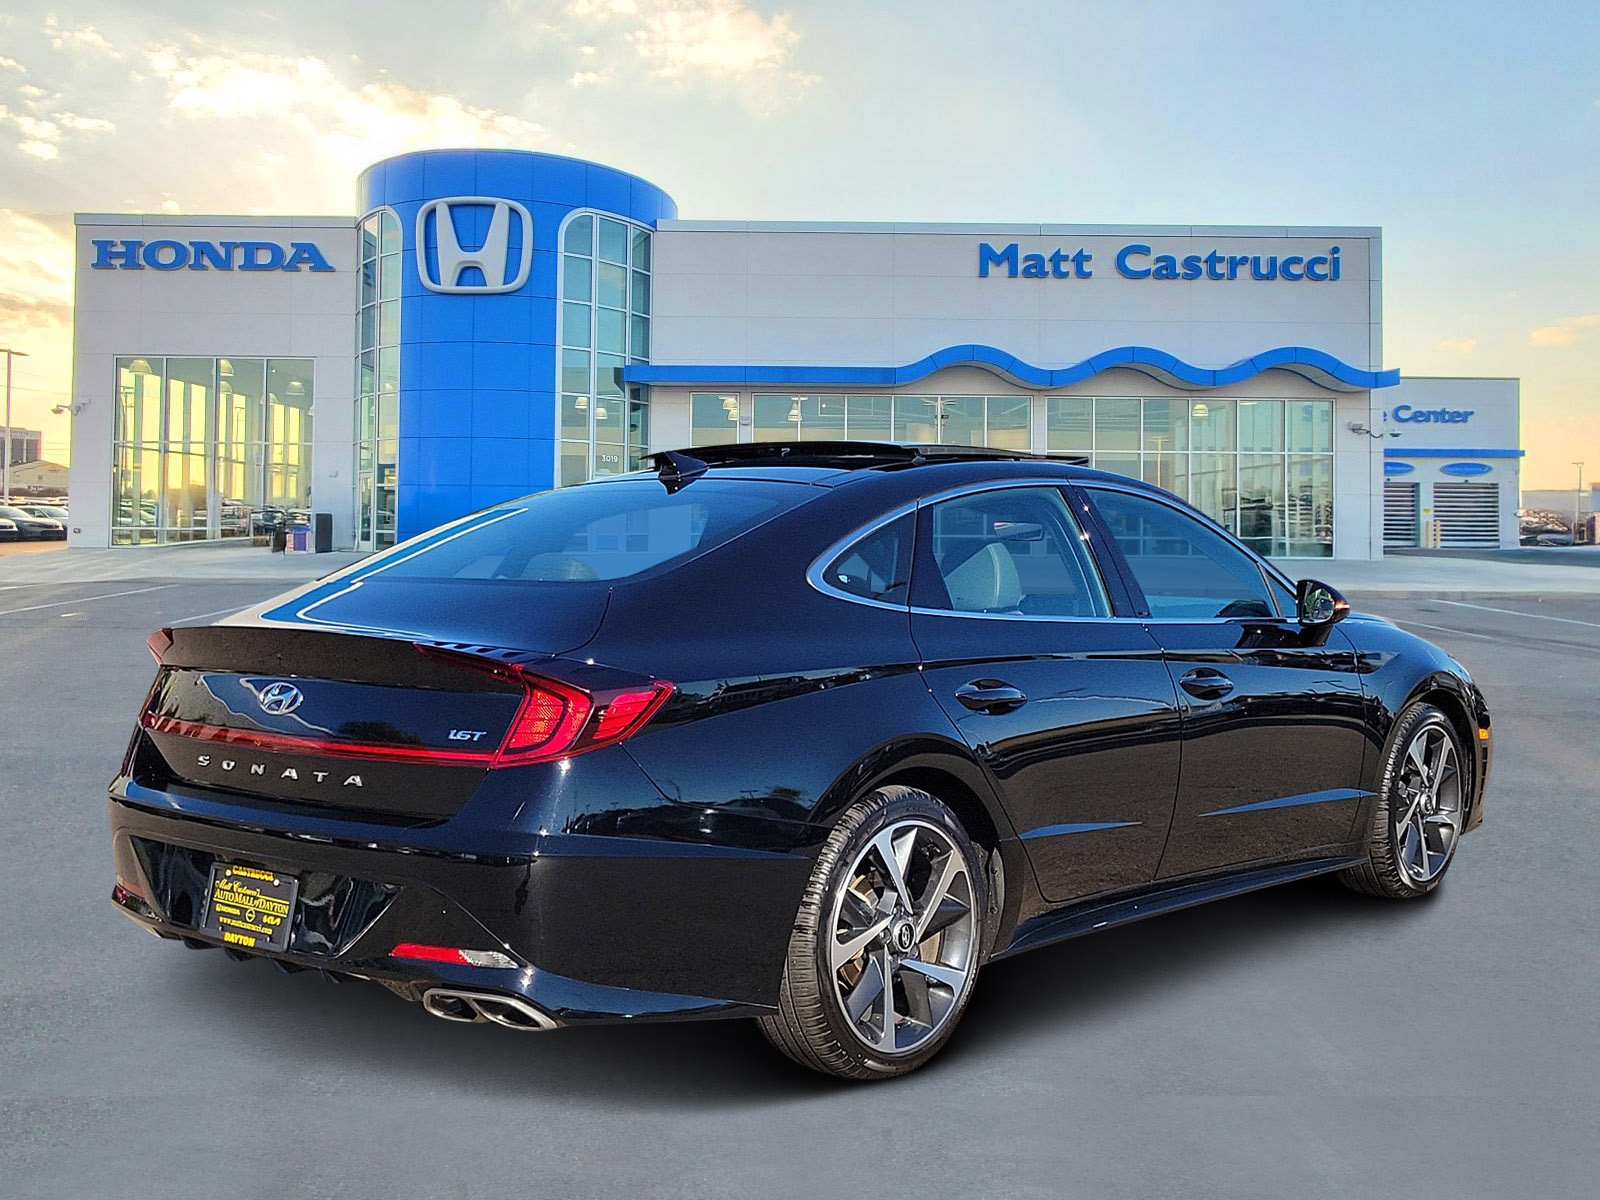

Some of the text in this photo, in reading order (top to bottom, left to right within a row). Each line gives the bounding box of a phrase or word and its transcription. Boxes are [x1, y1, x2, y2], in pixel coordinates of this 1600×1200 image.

[91, 239, 336, 272] HONDA
[979, 242, 1342, 281] Matt Castrucci
[1392, 404, 1474, 424] Center
[601, 455, 618, 463] 3019
[197, 755, 364, 788] SONATA
[224, 931, 256, 947] DAYTON
